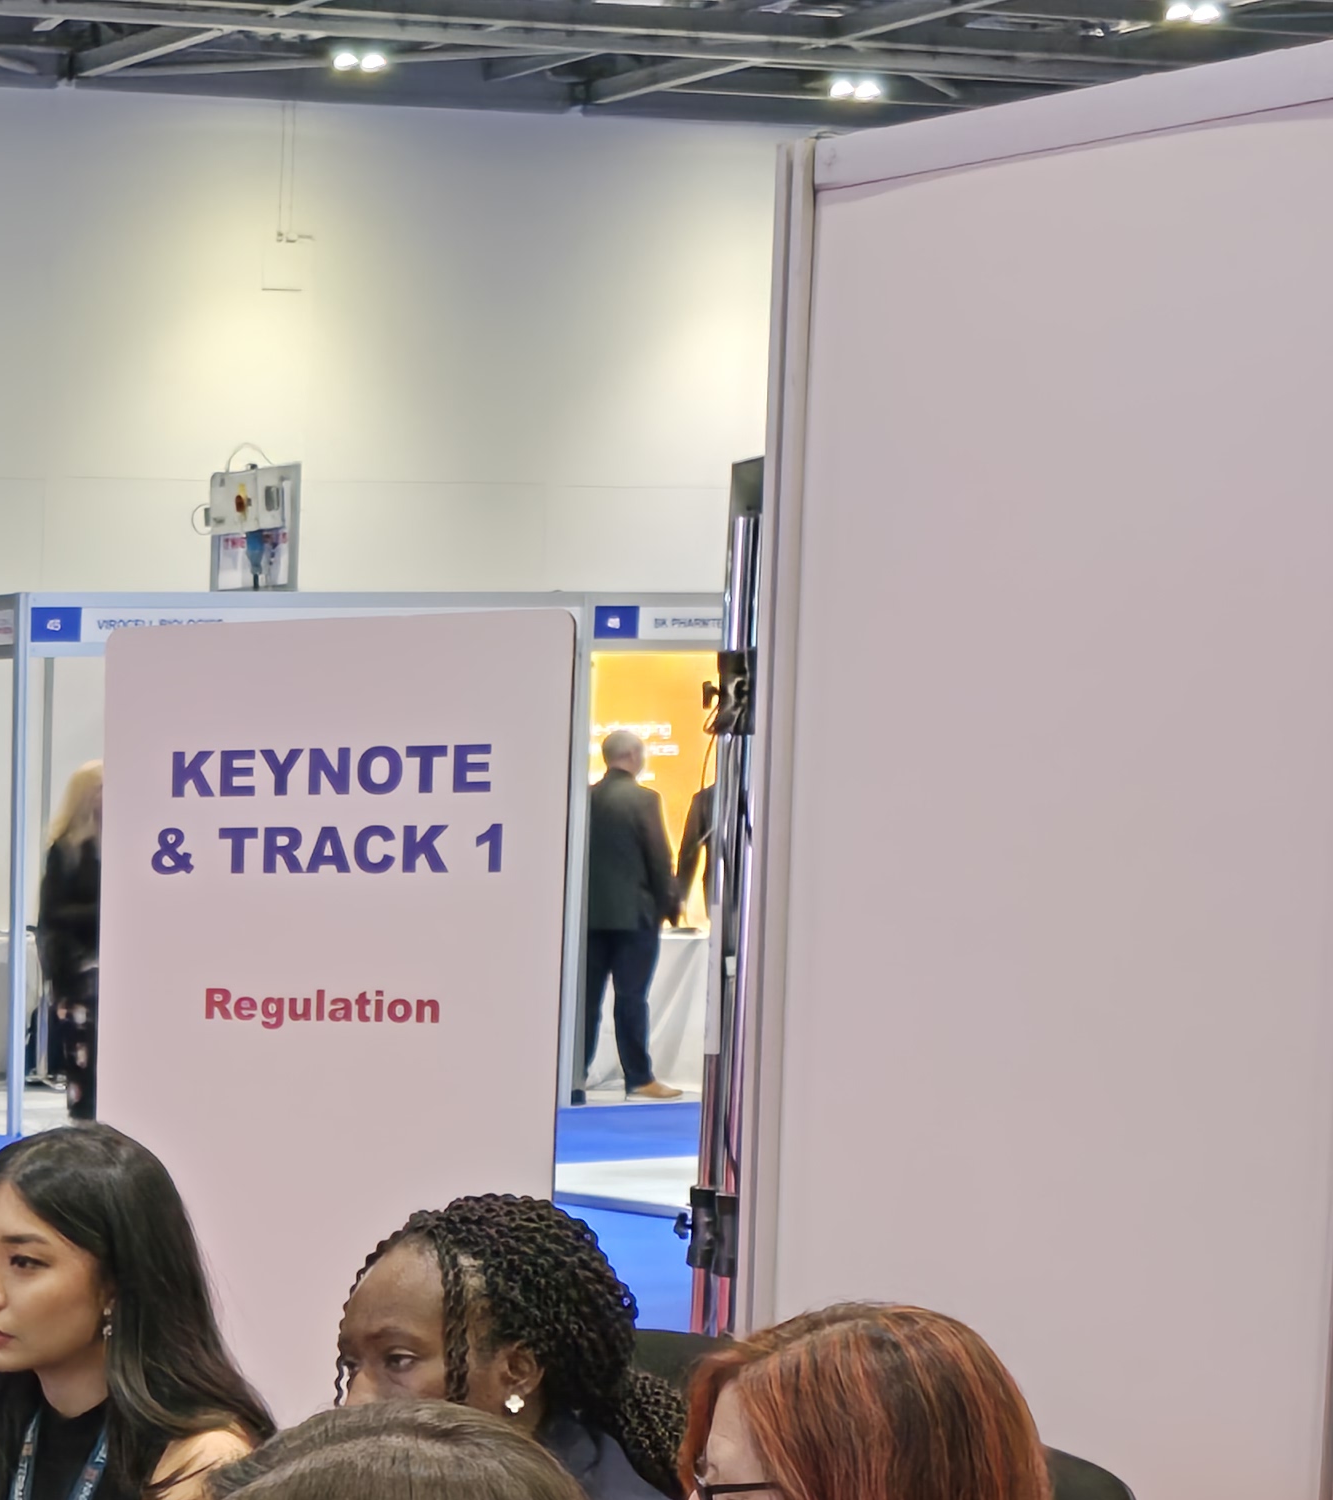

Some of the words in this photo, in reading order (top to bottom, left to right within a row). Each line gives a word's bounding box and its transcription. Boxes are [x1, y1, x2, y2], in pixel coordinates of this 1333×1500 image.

[171, 744, 492, 797] KEYNOTE
[151, 827, 194, 875] &
[218, 824, 449, 874] TRACK
[475, 823, 504, 873] 1
[204, 987, 440, 1030] Regulation
